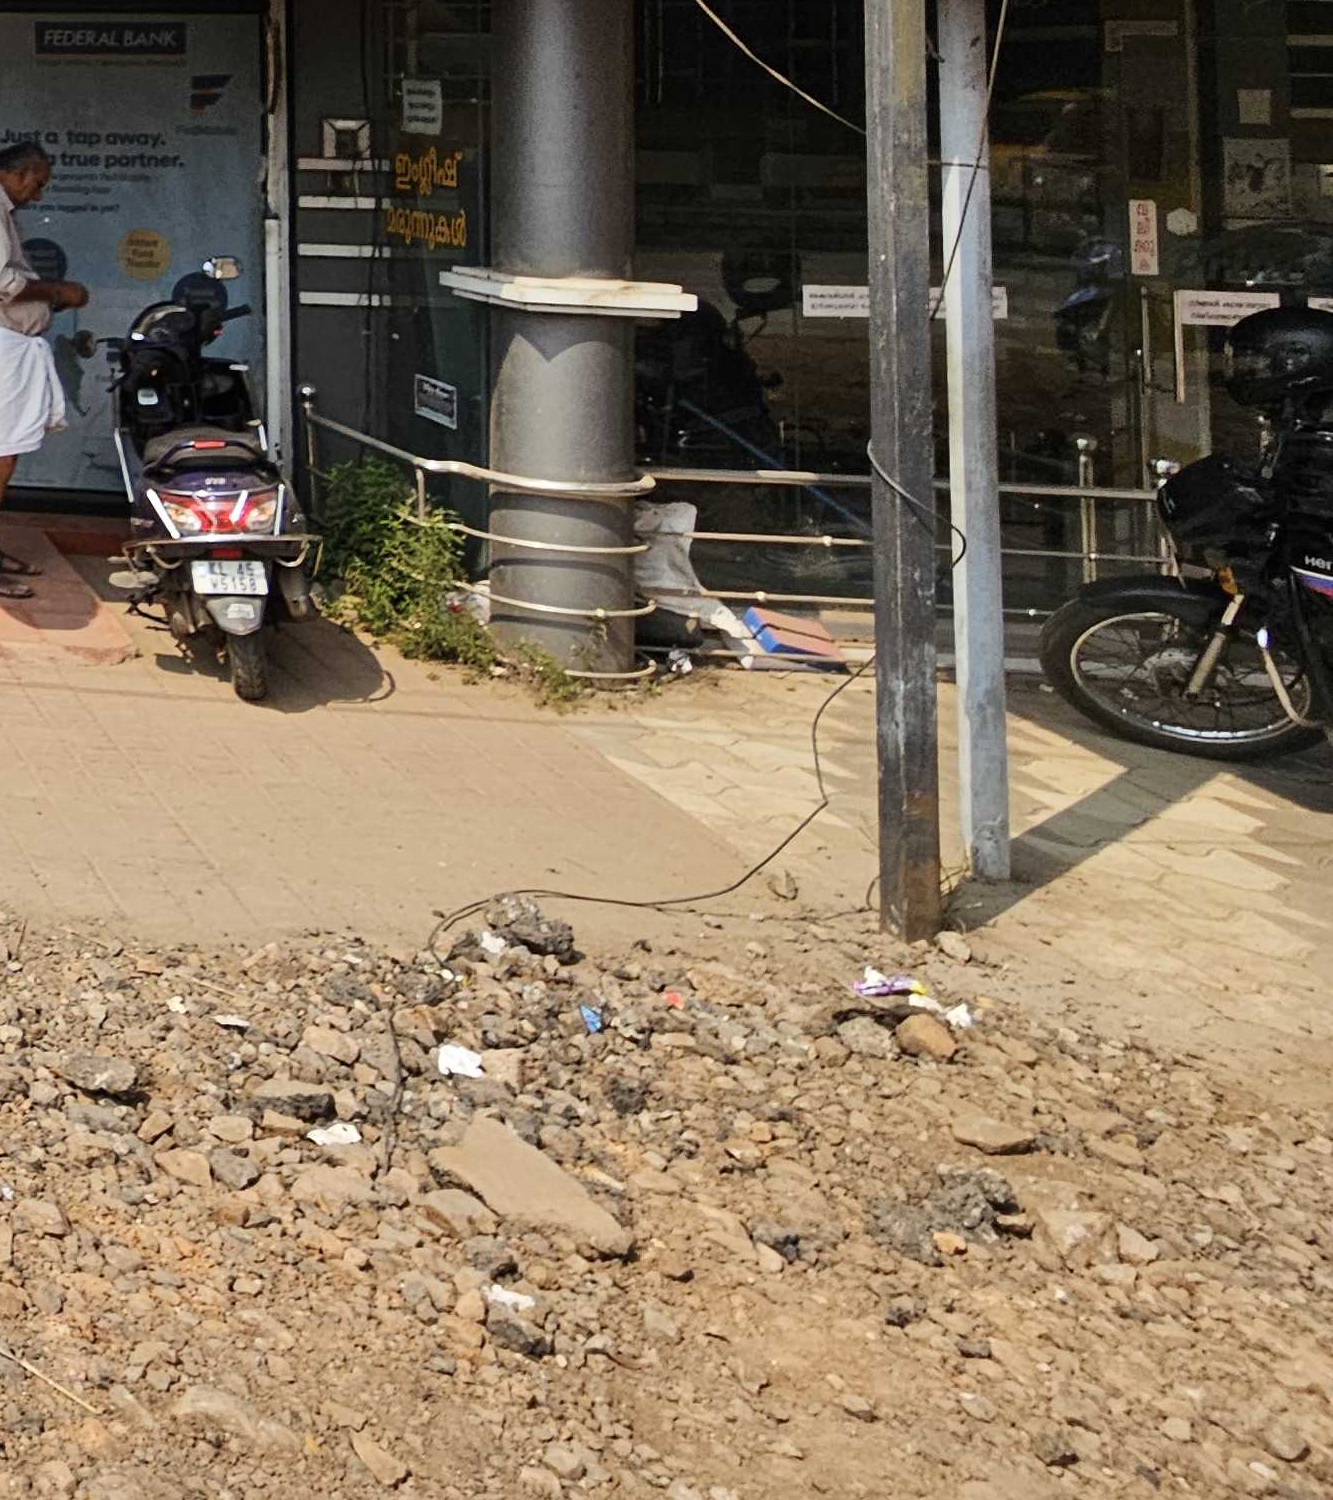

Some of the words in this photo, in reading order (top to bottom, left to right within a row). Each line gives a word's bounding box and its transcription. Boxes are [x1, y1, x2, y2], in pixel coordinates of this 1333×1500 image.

[43, 29, 119, 47] FEDERAL
[123, 29, 177, 47] BANK
[67, 130, 101, 149] tap
[105, 133, 166, 149] away.
[61, 153, 100, 168] true
[104, 152, 185, 170] partner.
